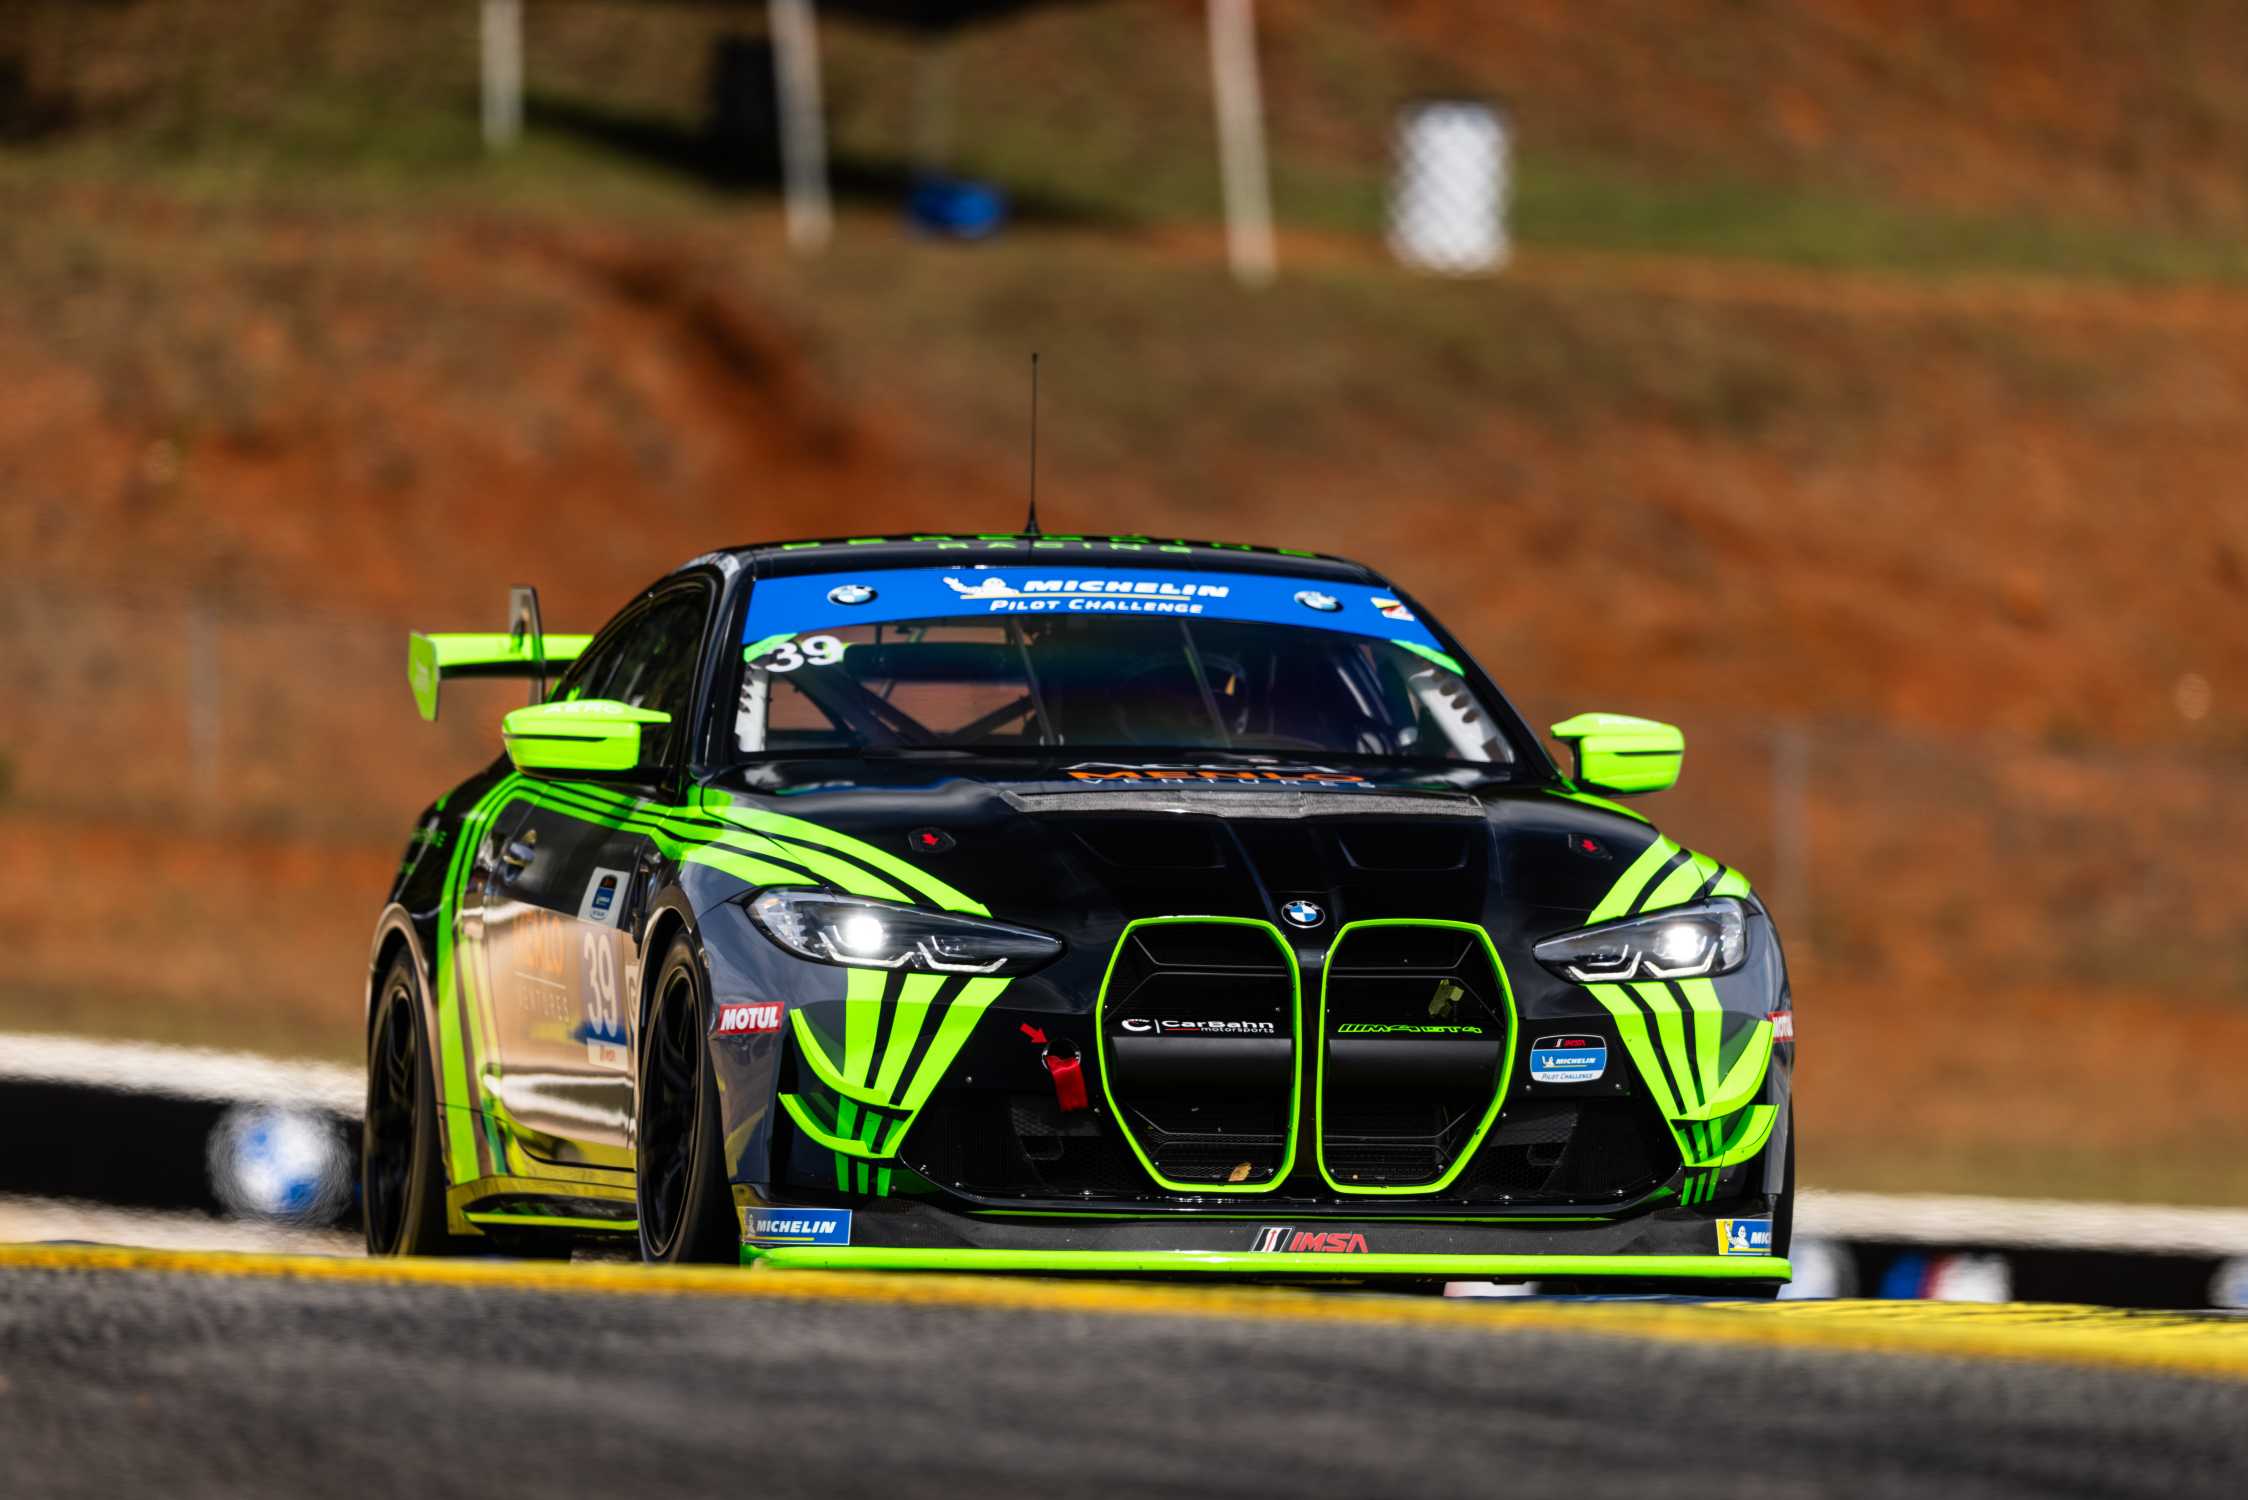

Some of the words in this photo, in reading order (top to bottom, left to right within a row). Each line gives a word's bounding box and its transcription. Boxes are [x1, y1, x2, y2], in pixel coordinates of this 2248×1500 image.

[1023, 580, 1229, 598] MICHELIN
[990, 600, 1060, 611] PILOT
[1068, 599, 1203, 614] CHALLENGE
[765, 635, 844, 672] 39
[583, 931, 618, 1038] 39
[720, 1006, 779, 1031] MOTUL
[1161, 1020, 1274, 1029] CarBahn
[1555, 1057, 1597, 1065] MICHELIN
[756, 1220, 837, 1234] MICHELIN
[1288, 1231, 1369, 1254] IMSA
